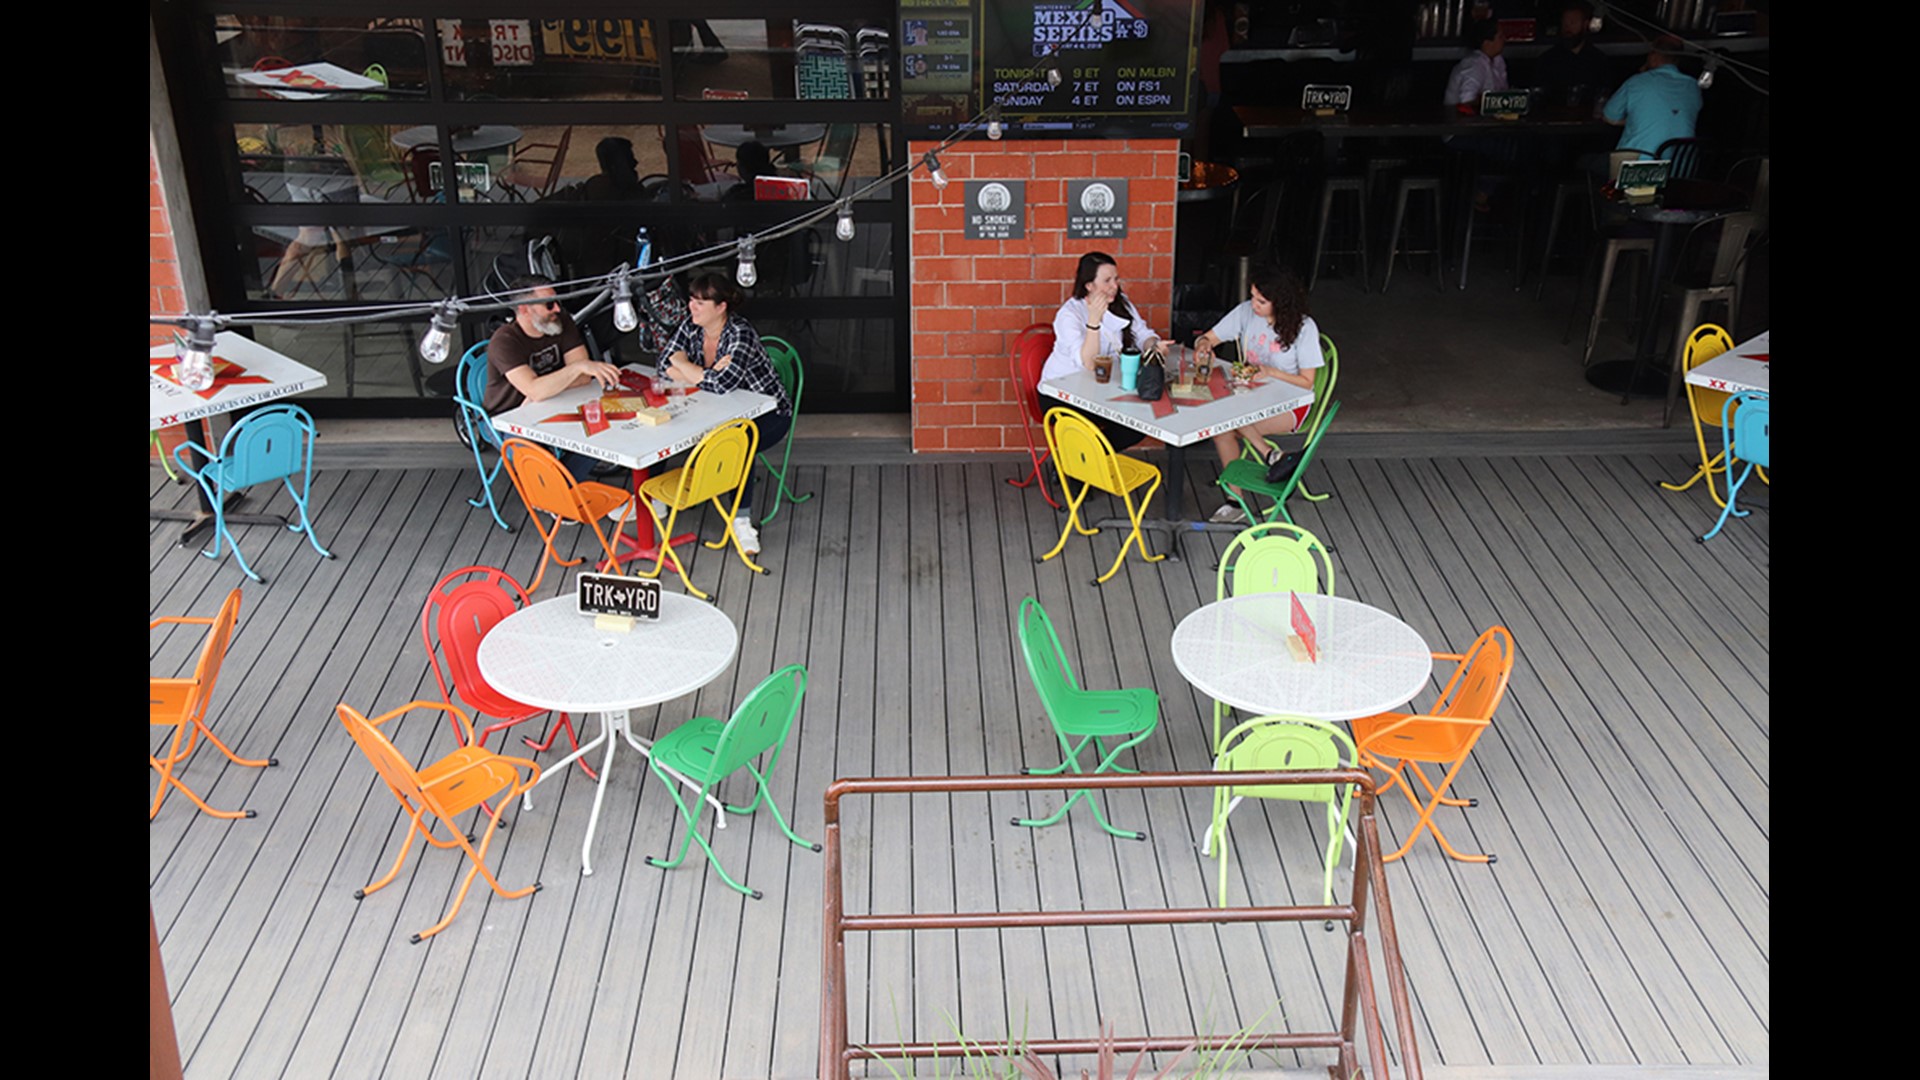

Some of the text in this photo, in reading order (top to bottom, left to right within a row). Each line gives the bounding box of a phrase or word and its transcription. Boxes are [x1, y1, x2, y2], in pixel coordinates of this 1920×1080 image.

[1034, 10, 1115, 25] MEXIO
[1033, 26, 1114, 42] SERIES
[994, 67, 1176, 79] TONIGHT 9 ET ON MLBN
[993, 81, 1160, 92] SATURDAY 7 ET ON FS1
[993, 95, 1171, 106] SUNDAY 4 ET ON ESPN
[972, 215, 1017, 225] NO SMOKING
[1709, 379, 1727, 390] XX
[160, 414, 179, 426] XX
[208, 400, 239, 413] EQUIS
[241, 394, 256, 404] ON
[258, 382, 305, 401] DRAUGHT
[1266, 400, 1299, 416] DRAUGHT
[1088, 403, 1111, 416] EQUIS
[1125, 417, 1162, 437] DRAUGHT
[543, 434, 567, 447] EQUIS
[581, 444, 620, 462] DRAUGHT
[583, 582, 657, 611] TRK YRD
